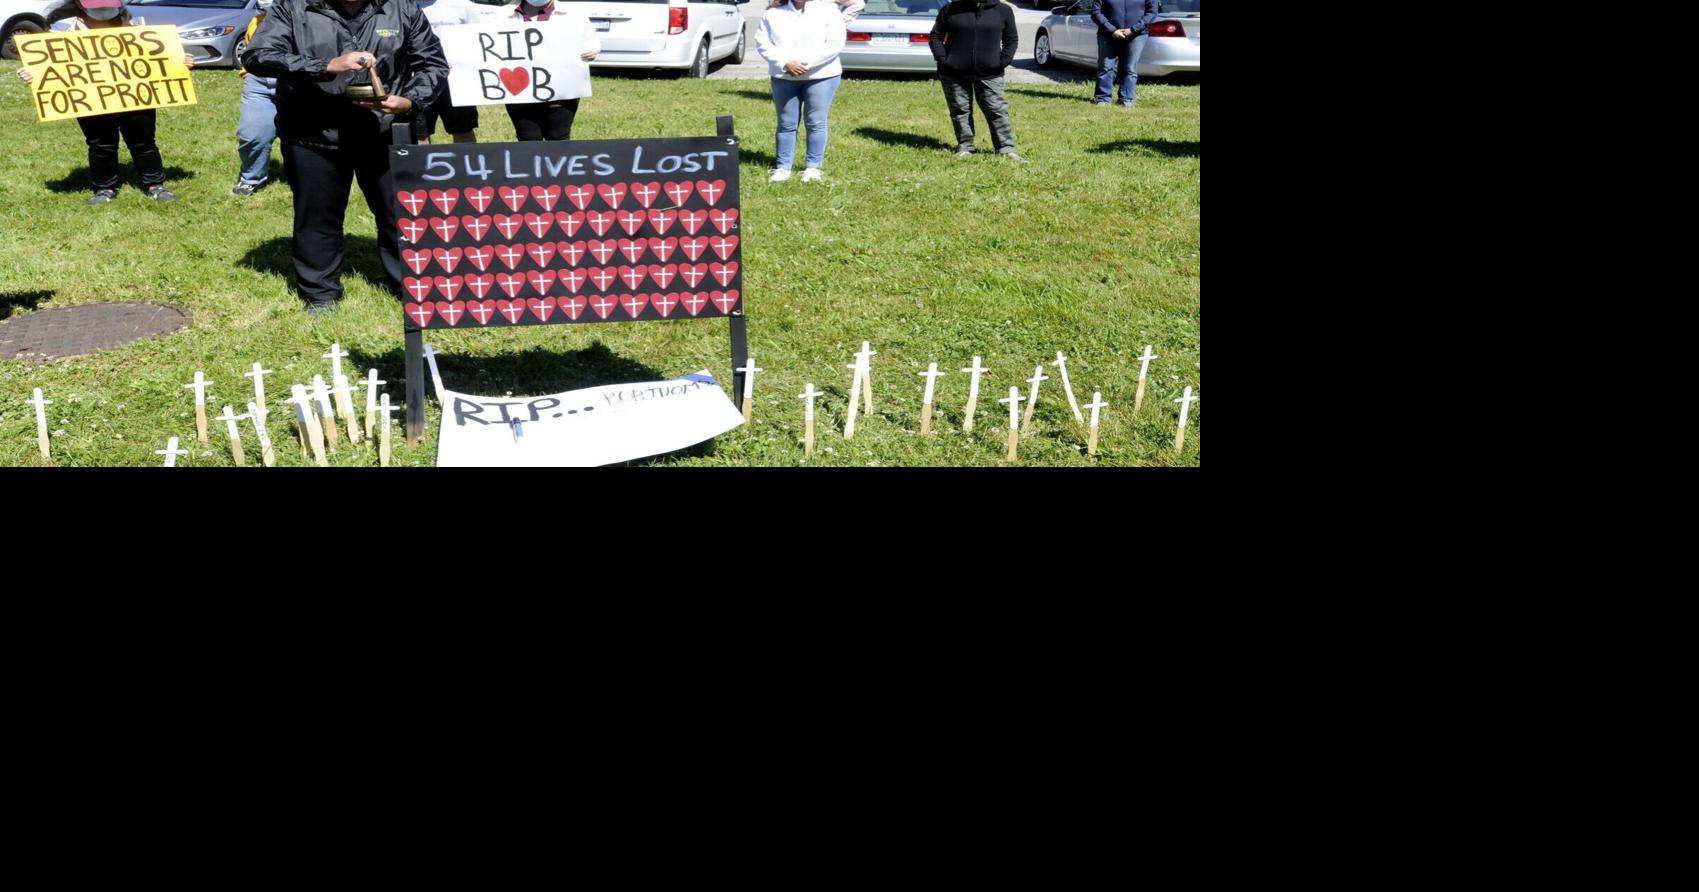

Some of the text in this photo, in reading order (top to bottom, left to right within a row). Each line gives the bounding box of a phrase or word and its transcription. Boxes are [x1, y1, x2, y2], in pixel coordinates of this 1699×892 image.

[21, 31, 165, 66] SENIORS
[478, 28, 543, 62] RIP
[38, 58, 169, 91] ARE NOT
[37, 78, 189, 119] FOR PROFIT
[421, 145, 728, 181] 54 LIVES LOST
